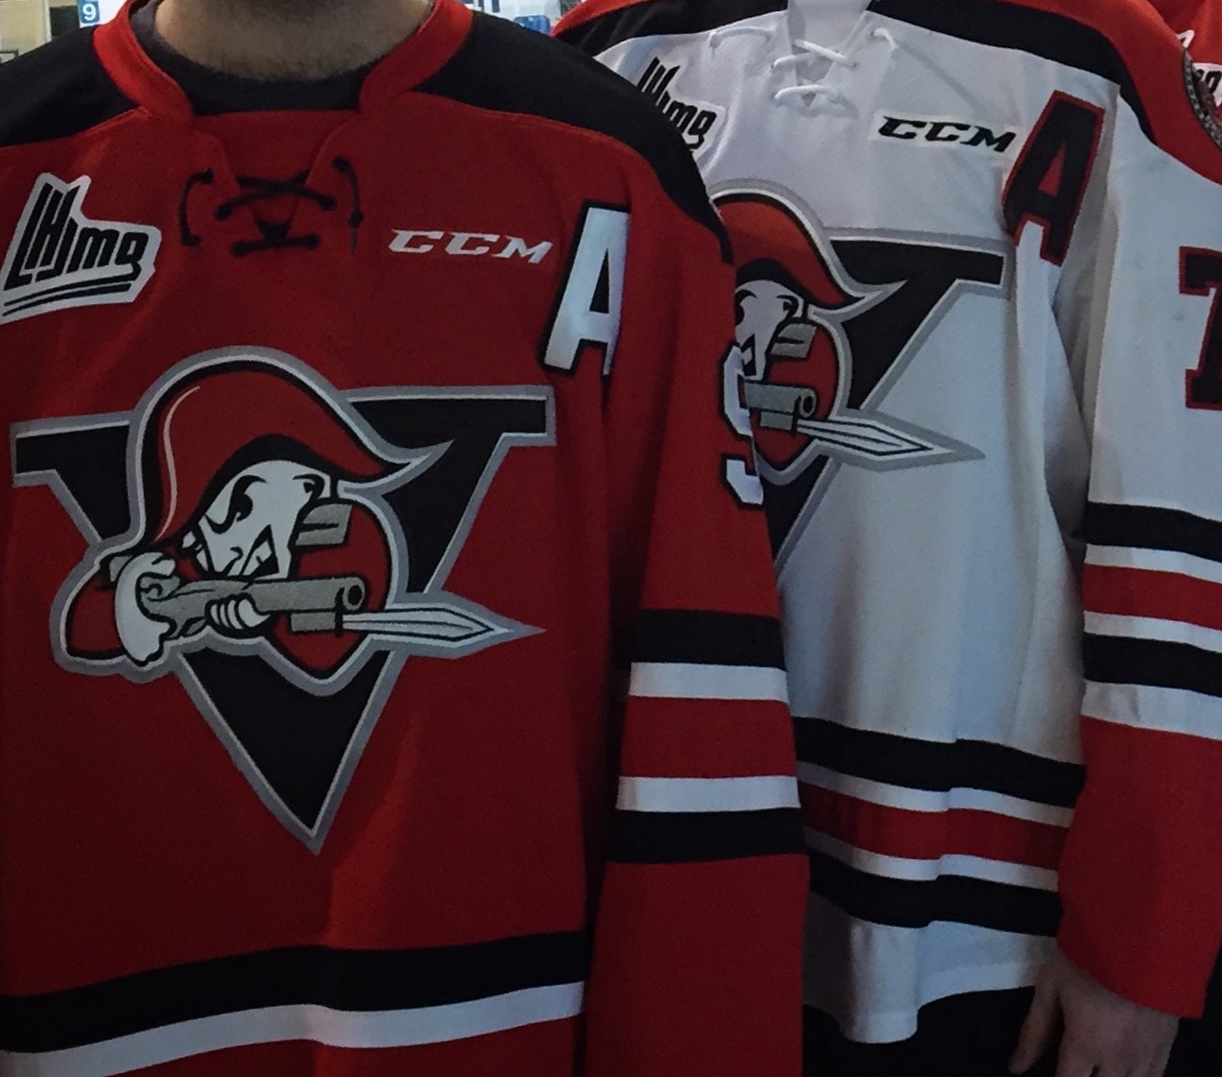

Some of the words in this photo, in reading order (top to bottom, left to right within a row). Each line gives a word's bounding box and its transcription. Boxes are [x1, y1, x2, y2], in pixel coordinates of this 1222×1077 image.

[82, 3, 97, 21] 9
[877, 115, 1016, 153] CCM
[1001, 89, 1106, 266] A
[387, 227, 555, 265] CCM
[540, 201, 633, 377] A
